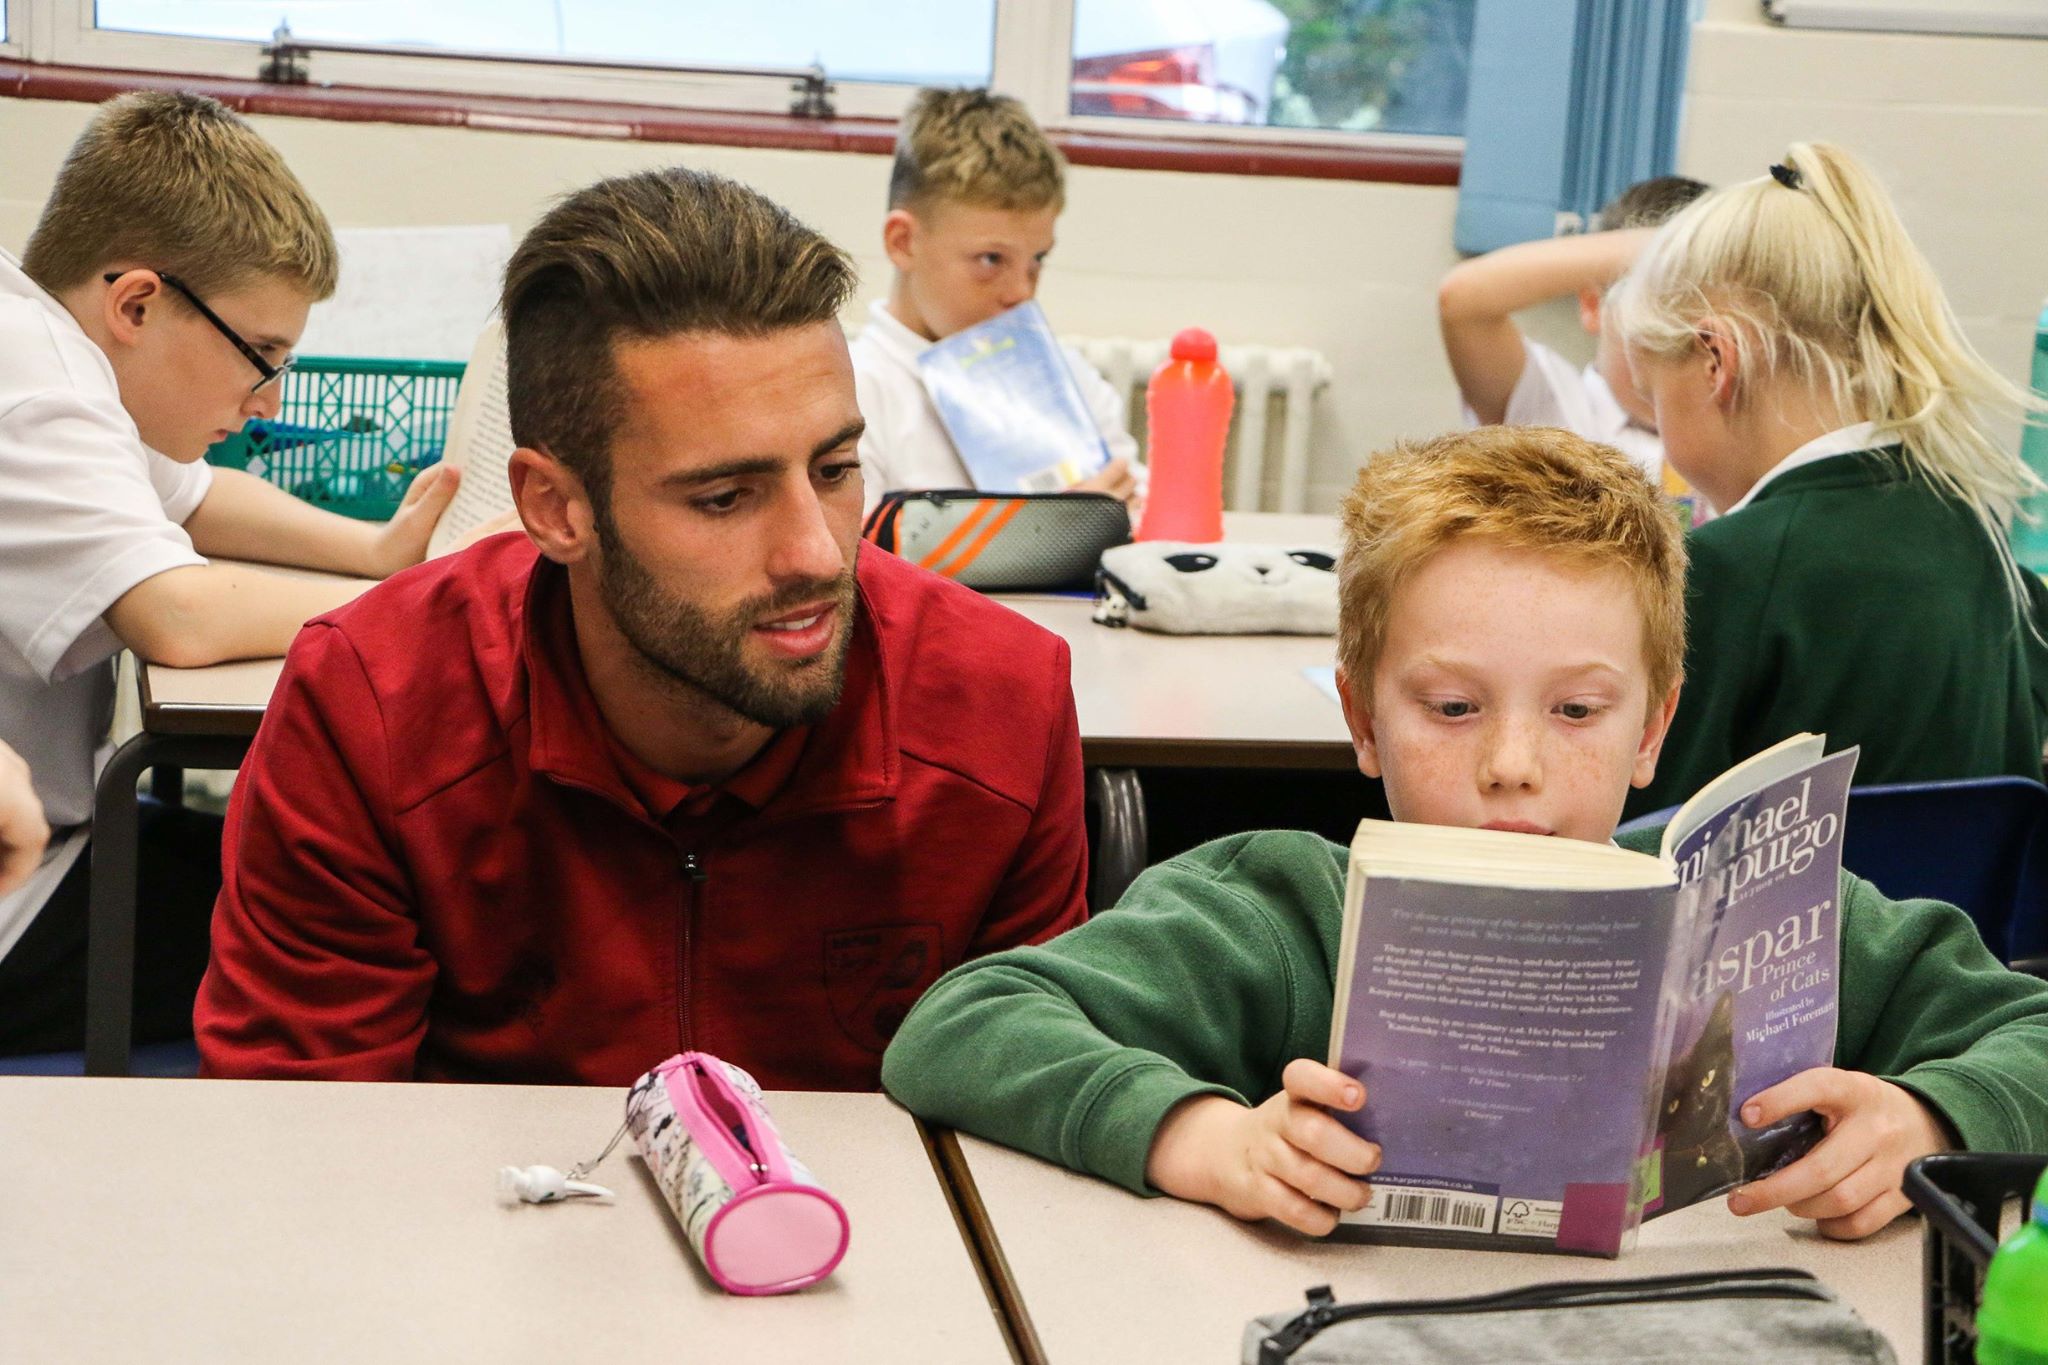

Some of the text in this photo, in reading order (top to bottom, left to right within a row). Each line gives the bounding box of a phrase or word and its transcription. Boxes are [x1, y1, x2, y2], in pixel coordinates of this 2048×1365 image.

[1676, 776, 1812, 893] mihael
[1690, 900, 1831, 1001] aspar
[1762, 951, 1817, 985] Prince
[1770, 968, 1831, 1002] of Cats
[1745, 1001, 1835, 1043] Michael Foreman
